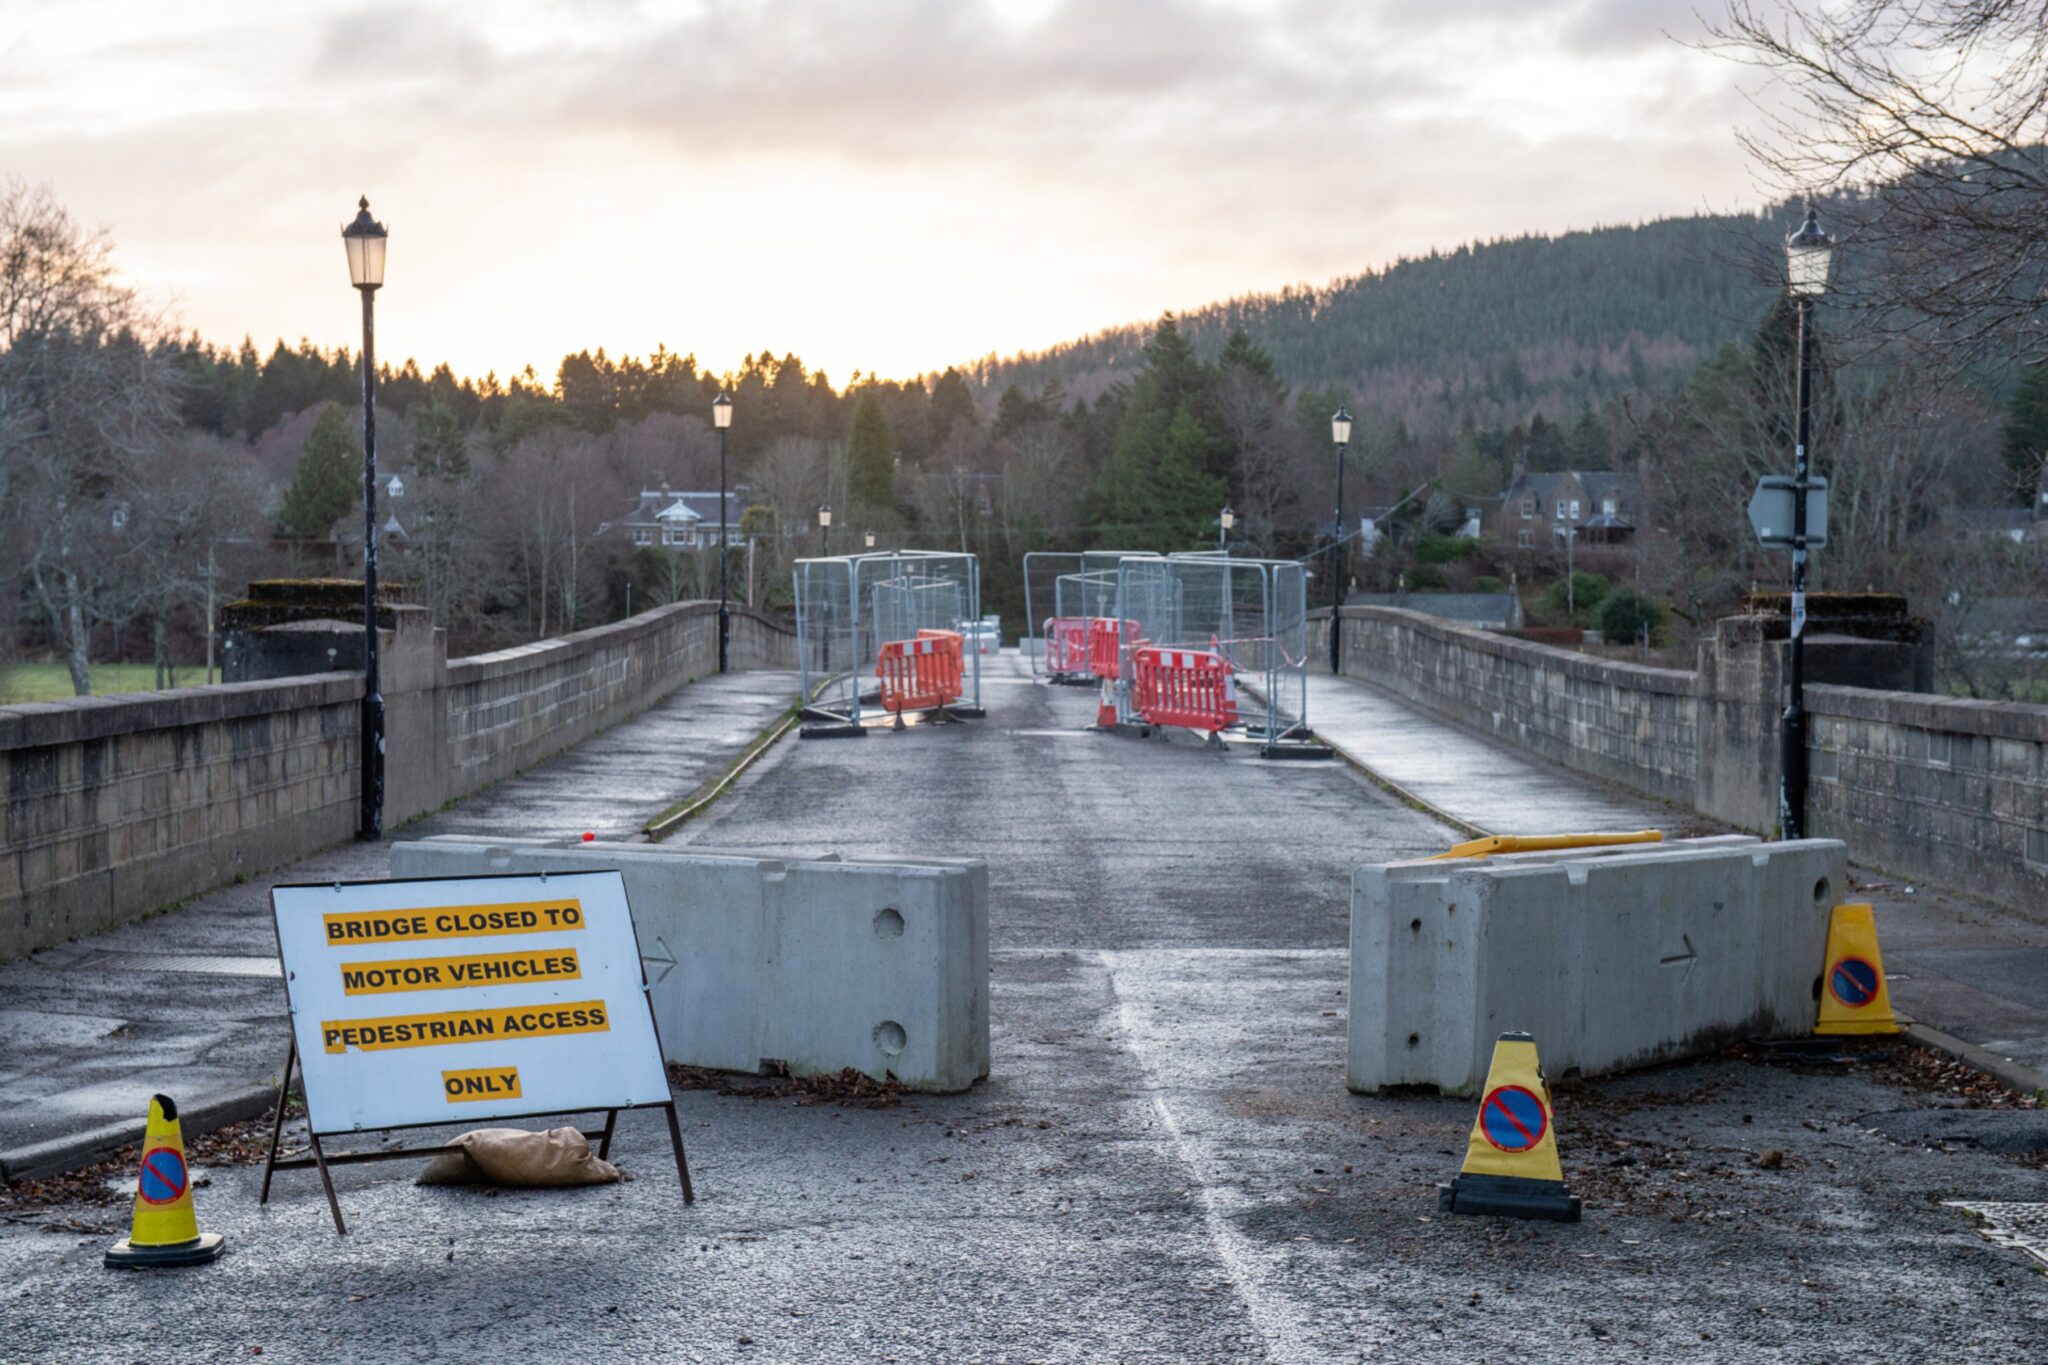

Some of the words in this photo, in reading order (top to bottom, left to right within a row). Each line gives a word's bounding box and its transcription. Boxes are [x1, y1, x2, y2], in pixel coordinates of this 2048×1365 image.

[327, 916, 428, 939] BRIDGE
[436, 911, 538, 932] CLOSED
[544, 908, 580, 926] TO
[344, 967, 441, 989] MOTOR
[448, 957, 577, 981] VEHICLES
[325, 1018, 495, 1047] PEDESTRIAN
[504, 1009, 606, 1033] ACCESS
[445, 1074, 517, 1096] ONLY
